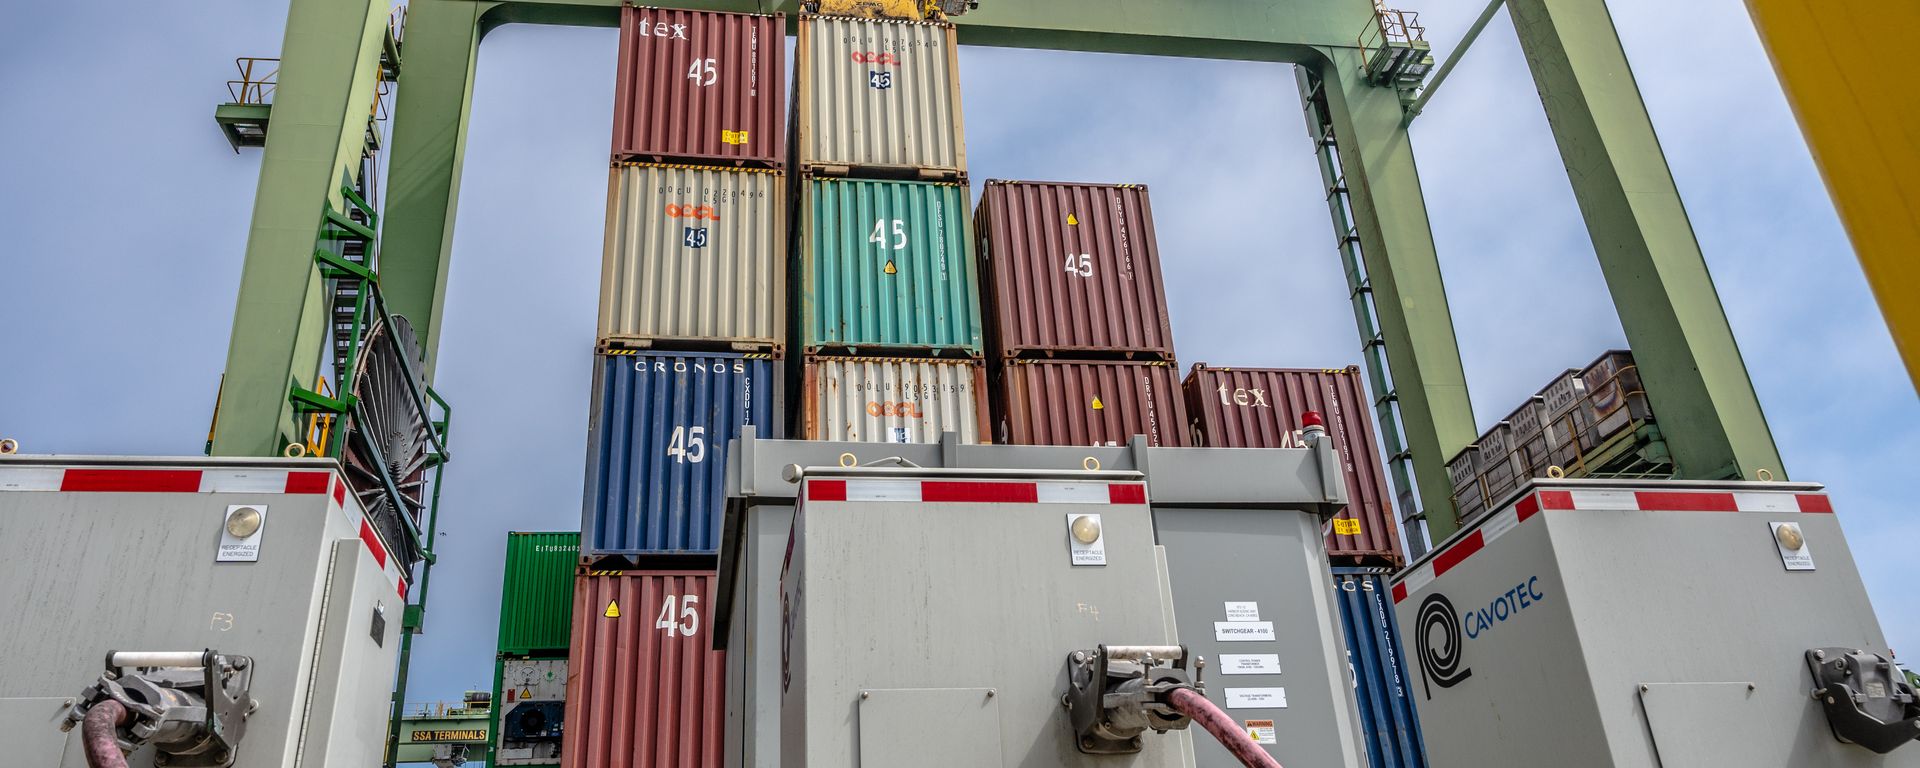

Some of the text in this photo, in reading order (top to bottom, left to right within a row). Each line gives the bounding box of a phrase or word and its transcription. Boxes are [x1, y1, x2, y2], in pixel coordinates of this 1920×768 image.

[639, 17, 688, 40] tex
[843, 36, 938, 49] OOLU 9076540
[687, 58, 718, 87] 45
[870, 73, 890, 88] 45
[658, 186, 764, 199] OOCU 0220496
[665, 203, 721, 221] OOCL
[1116, 197, 1125, 225] DRYU
[686, 228, 706, 247] 45
[869, 218, 908, 250] 45
[1120, 227, 1132, 270] 456166
[1064, 253, 1094, 278] 45
[634, 361, 744, 374] CRONOS
[856, 381, 966, 394] OOLU 9053159
[1144, 376, 1153, 409] DRYU
[1216, 382, 1269, 408] tex
[1329, 385, 1340, 415] TEMU
[667, 425, 705, 465] 45
[1334, 581, 1374, 592] OS
[655, 594, 700, 638] 45
[1465, 576, 1543, 639] CAVOTEC
[210, 611, 234, 631] F3
[413, 730, 486, 741] SSA TERMINALS
